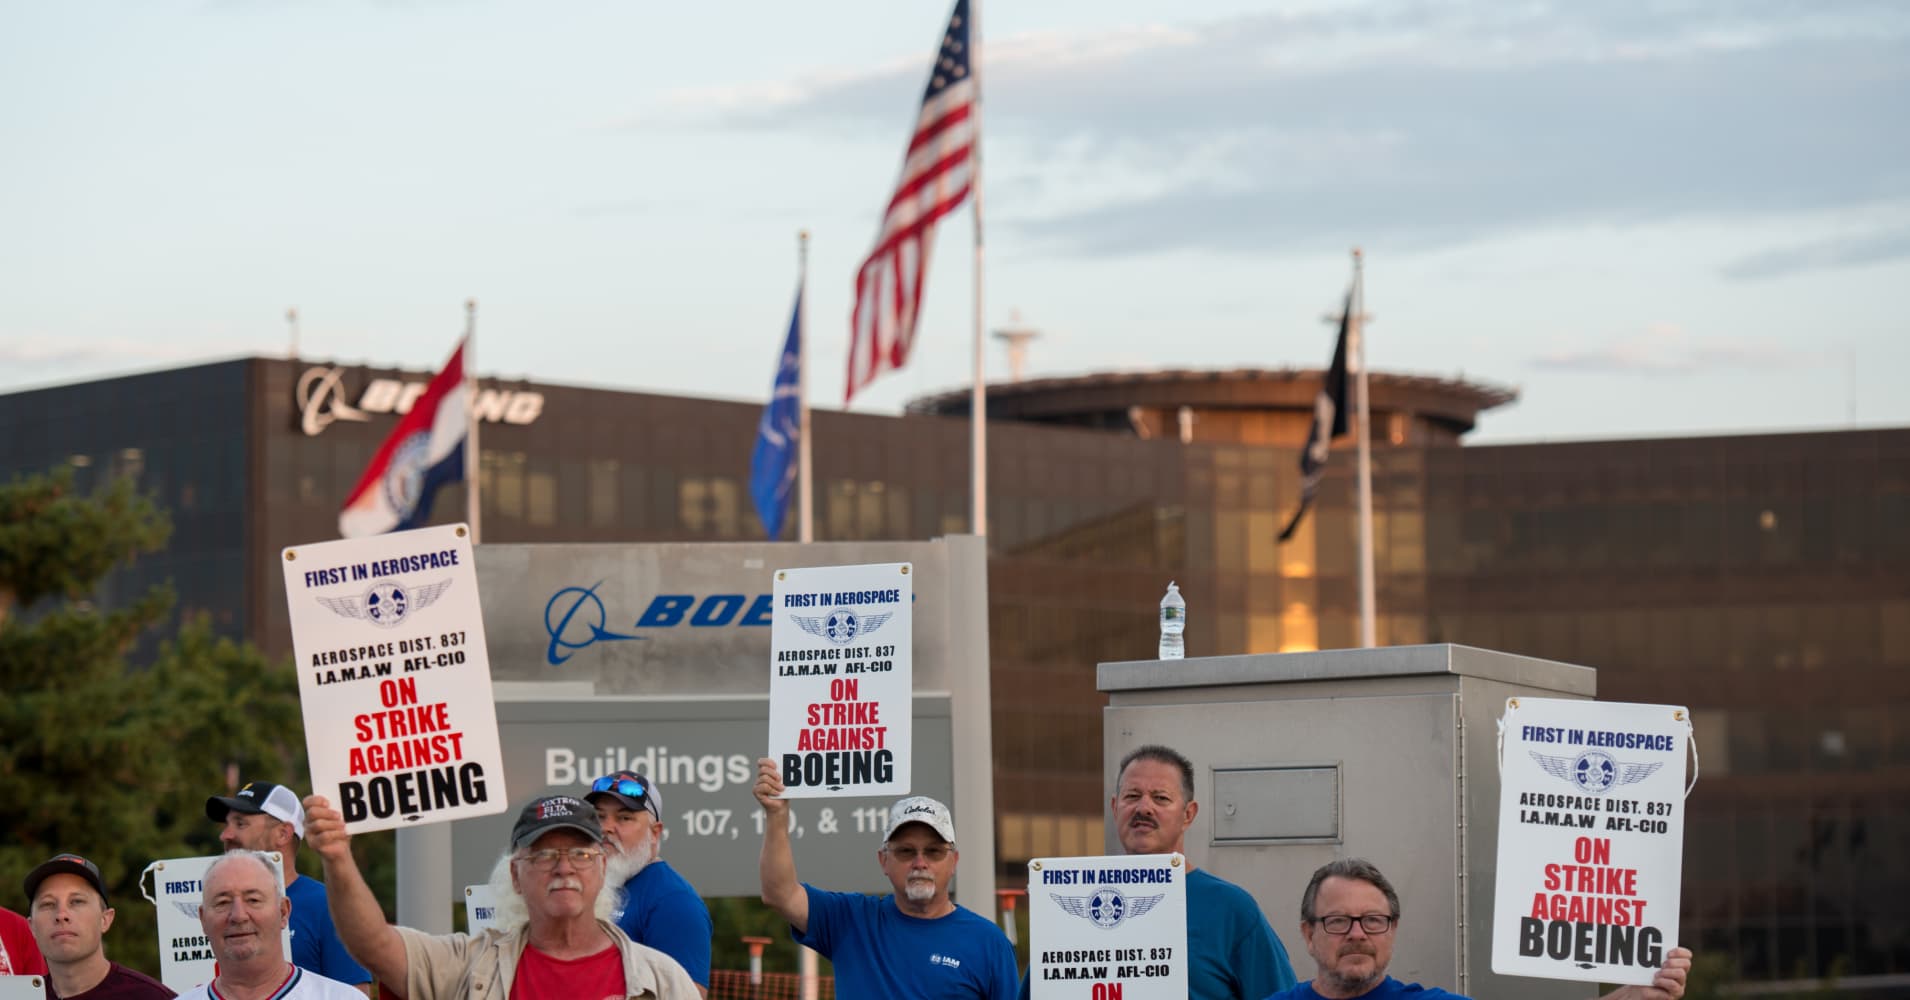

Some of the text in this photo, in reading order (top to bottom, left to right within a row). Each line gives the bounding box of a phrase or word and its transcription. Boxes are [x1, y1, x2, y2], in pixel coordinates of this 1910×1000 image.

[305, 550, 459, 588] FIRST IN AEROSPACE
[784, 589, 900, 608] FIRST IN AEROSPACE
[312, 632, 466, 667] AEROSPACE DIST. 837
[778, 646, 895, 662] AEROSPACE DIST. 837
[317, 651, 466, 686] I.A.M.A.W AFL-CIO
[779, 661, 892, 676] I.A.M.A.W AFL-CIO
[380, 677, 417, 708] ON
[830, 678, 858, 701] ON
[354, 703, 450, 743] STRIKE
[808, 702, 879, 726] STRIKE
[798, 727, 886, 752] AGAINST
[1522, 726, 1673, 752] FIRST IN AEROSPACE
[350, 732, 462, 776] AGAINST
[782, 750, 892, 786] BOEING
[546, 746, 750, 792] Buildings
[339, 762, 487, 824] BOEING
[1520, 792, 1672, 816] AEROSPACE DIST. 837
[682, 809, 739, 840] 107,
[818, 808, 838, 834] &
[1521, 810, 1668, 834] I.A.M.A.W AFL-CIO
[1575, 836, 1610, 866] ON
[166, 880, 204, 894] FIRST I
[1044, 868, 1172, 884] FIRST IN AEROSPACE
[1544, 864, 1636, 896] STRIKE
[1531, 893, 1646, 926] AGAINST
[1042, 948, 1172, 964] AEROSPACE DIST. 837
[1520, 916, 1662, 968] BOEING
[1044, 964, 1169, 980] I.A.M.A.W AFL-CIO
[1092, 982, 1122, 1000] ON
